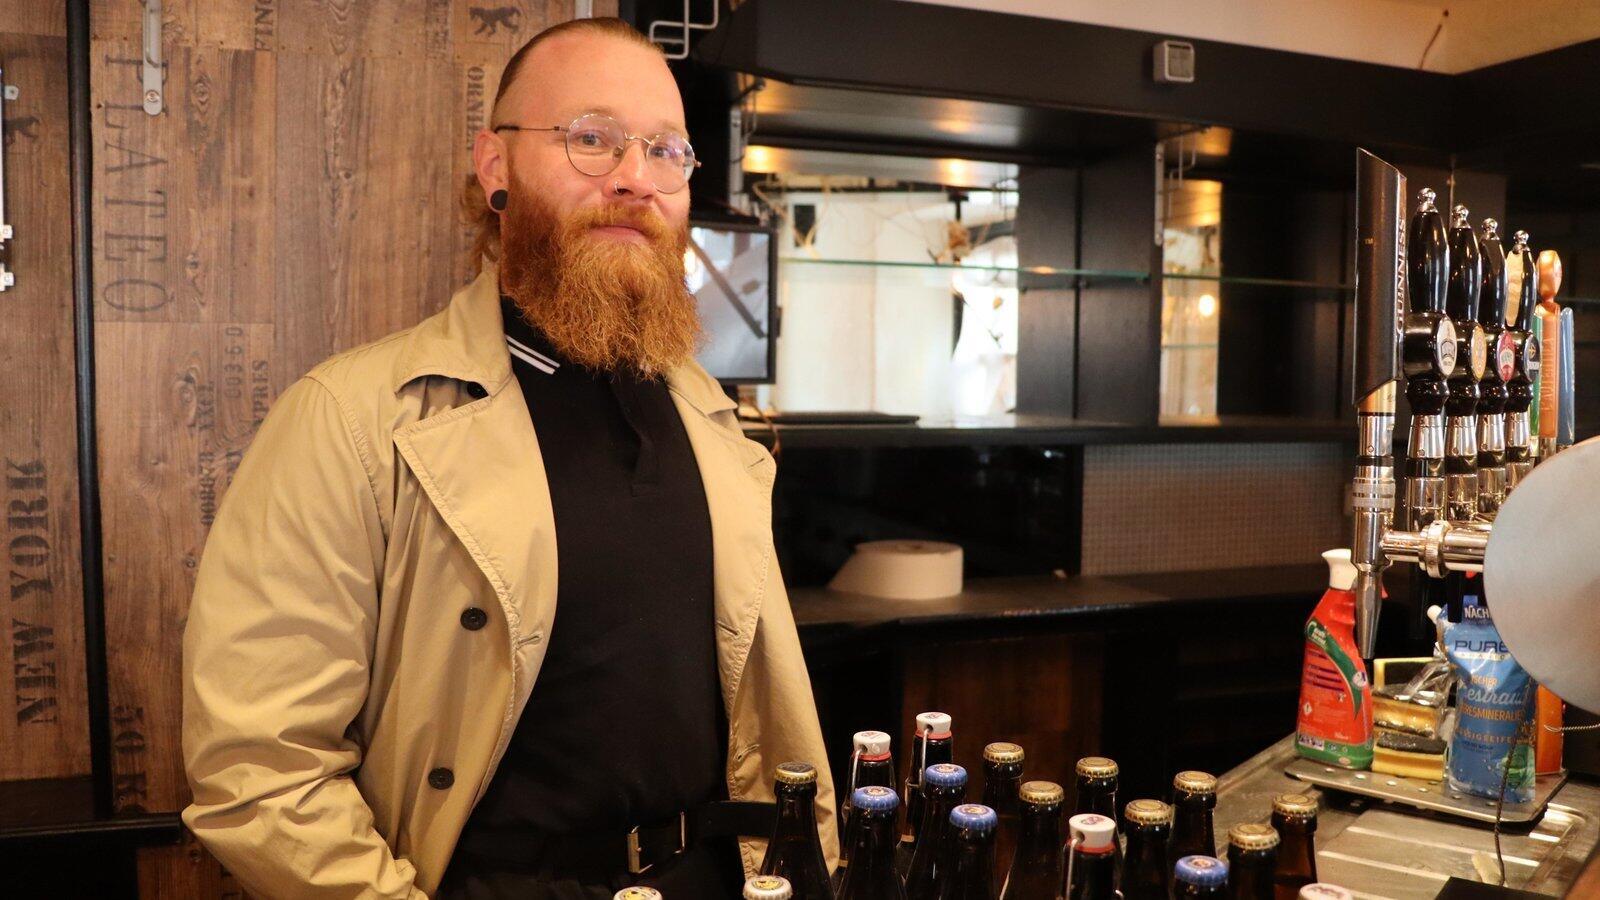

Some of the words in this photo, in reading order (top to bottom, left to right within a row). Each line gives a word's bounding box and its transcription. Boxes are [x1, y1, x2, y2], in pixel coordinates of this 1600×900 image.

[1396, 217, 1407, 335] GUINNESS
[5, 457, 52, 601] YORK
[1454, 640, 1509, 653] PURE
[1464, 605, 1491, 619] NACH
[11, 617, 57, 727] NEW
